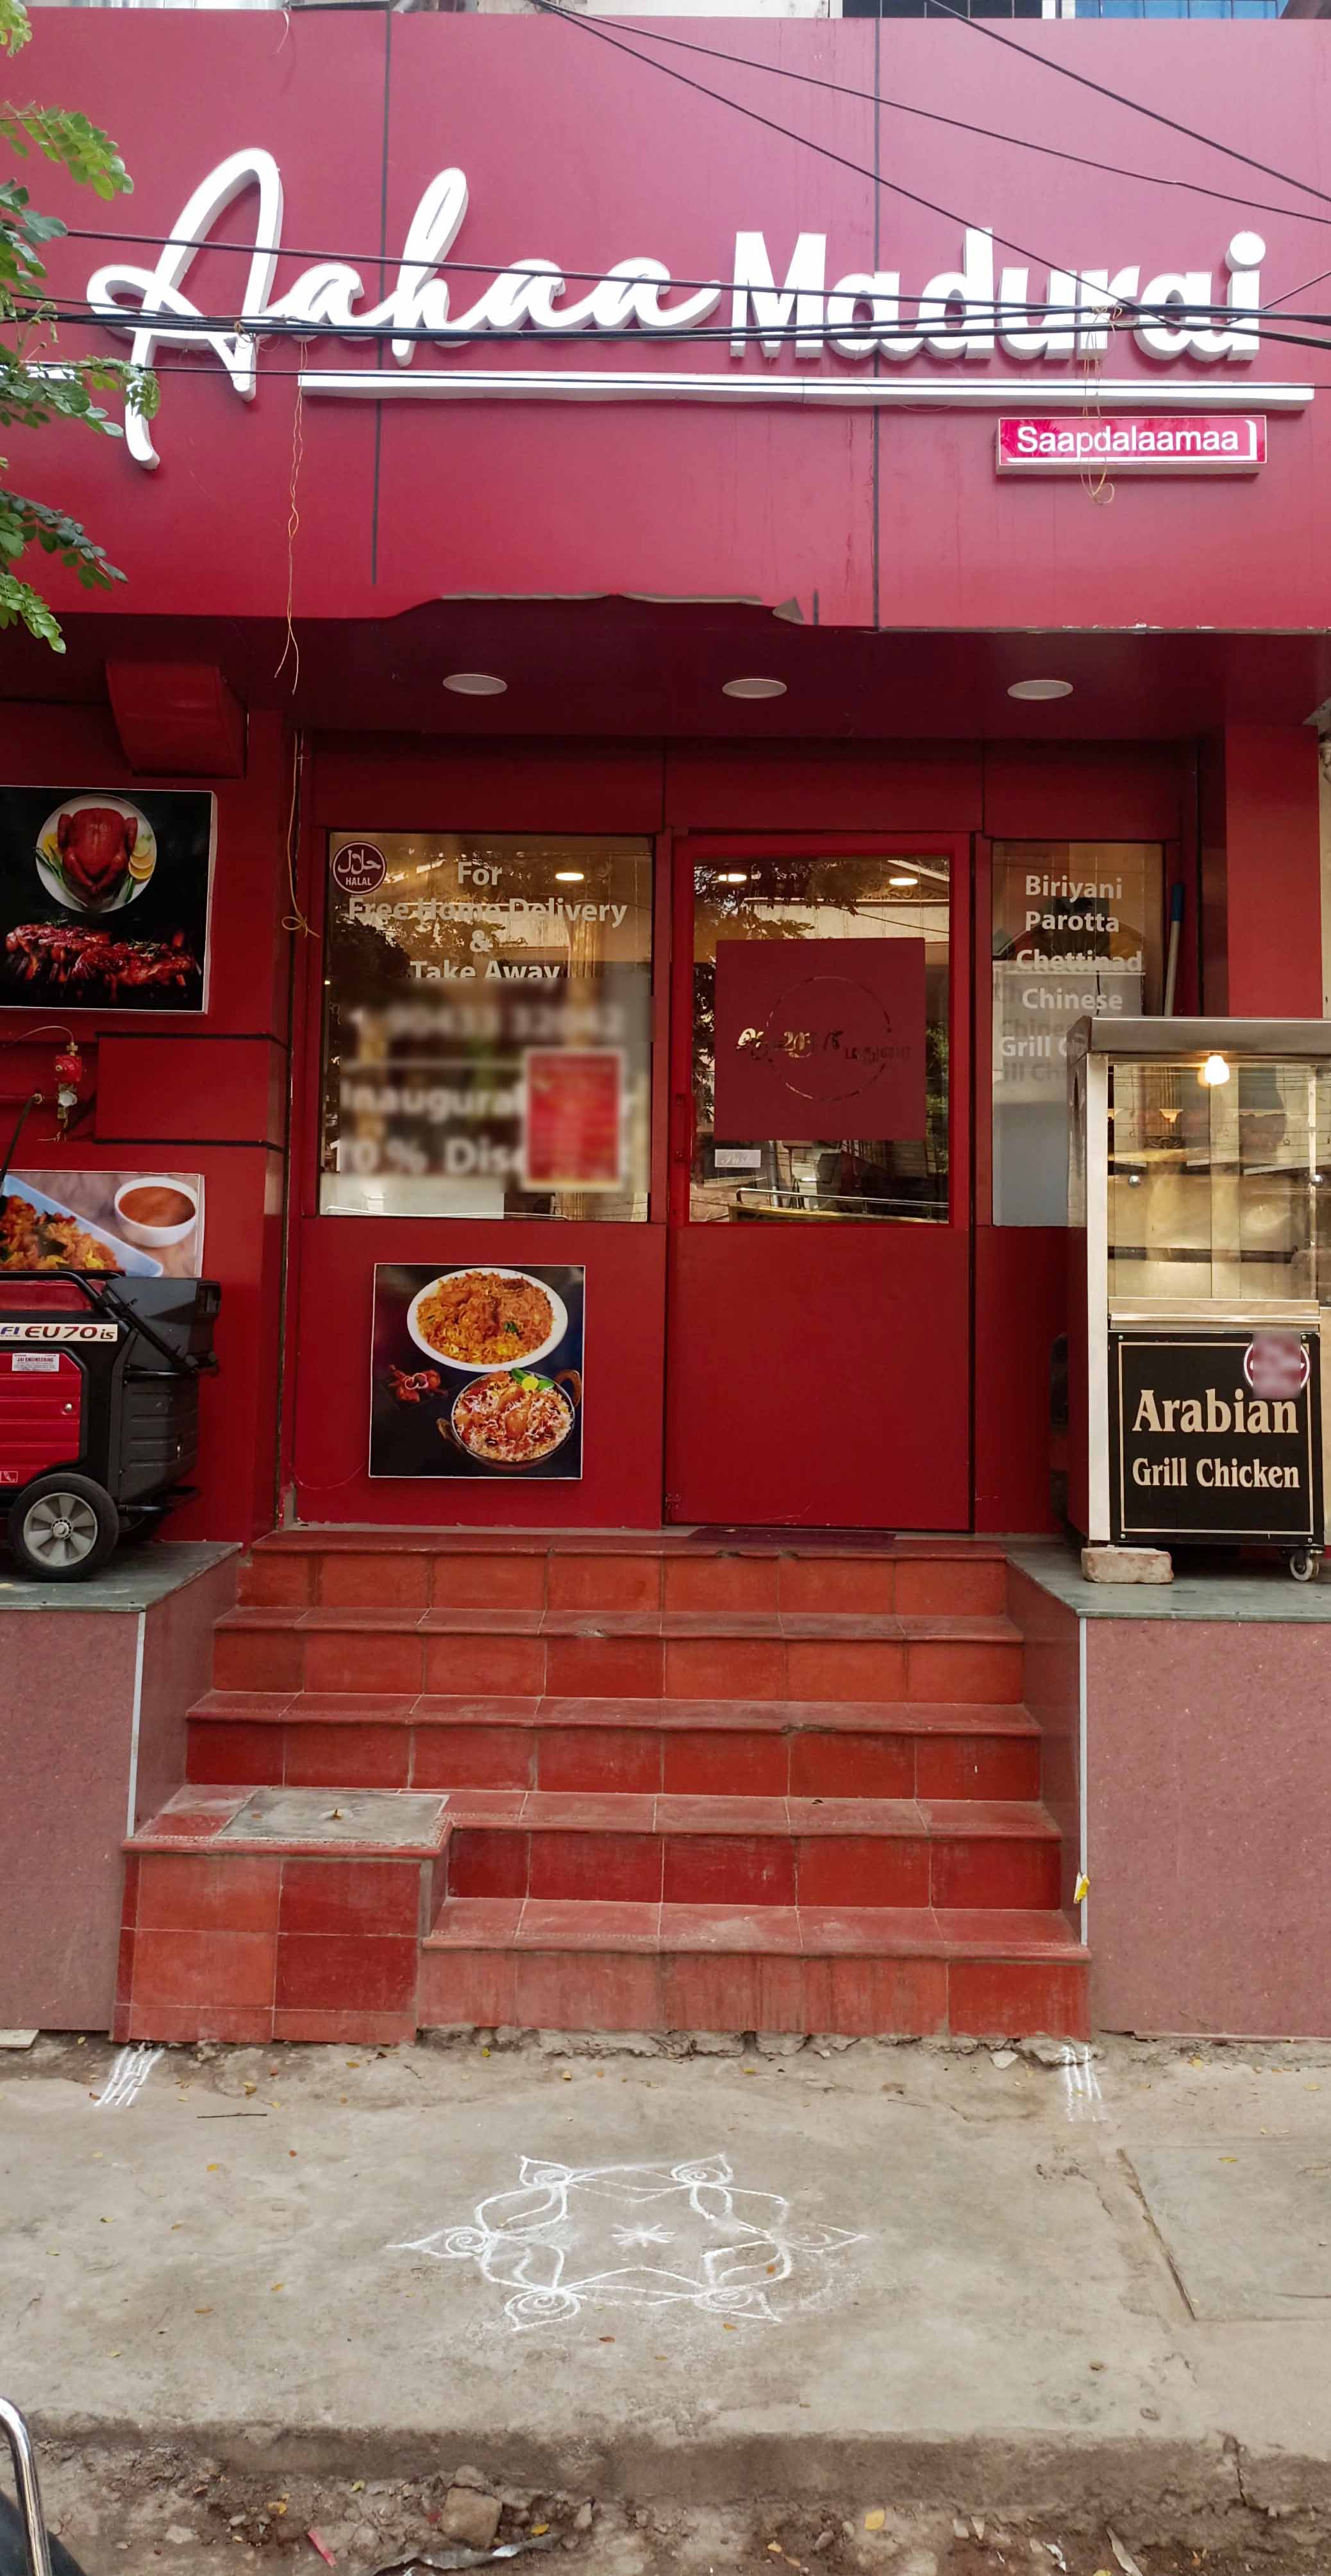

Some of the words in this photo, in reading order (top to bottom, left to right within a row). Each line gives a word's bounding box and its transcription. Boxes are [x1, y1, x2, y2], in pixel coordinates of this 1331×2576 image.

[87, 147, 721, 470] Aahaa
[730, 227, 1266, 361] Madurai
[1017, 426, 1239, 458] Saapdalaamaa
[337, 849, 381, 875] حلال
[458, 861, 503, 886] For
[346, 877, 373, 886] HALAL
[1025, 874, 1123, 903] Biriyani
[349, 897, 414, 921] Free
[417, 897, 502, 921] Home
[510, 897, 628, 928] Delivery
[1026, 911, 1120, 933] Parotta
[469, 929, 494, 953] &
[410, 960, 476, 981] Take
[1016, 949, 1143, 972] Chettinad
[1022, 987, 1123, 1010] Chinese
[1000, 1035, 1051, 1058] Grill
[1132, 1388, 1299, 1434] Arabian
[1132, 1457, 1188, 1486] Grill
[1196, 1458, 1300, 1488] Chicken
